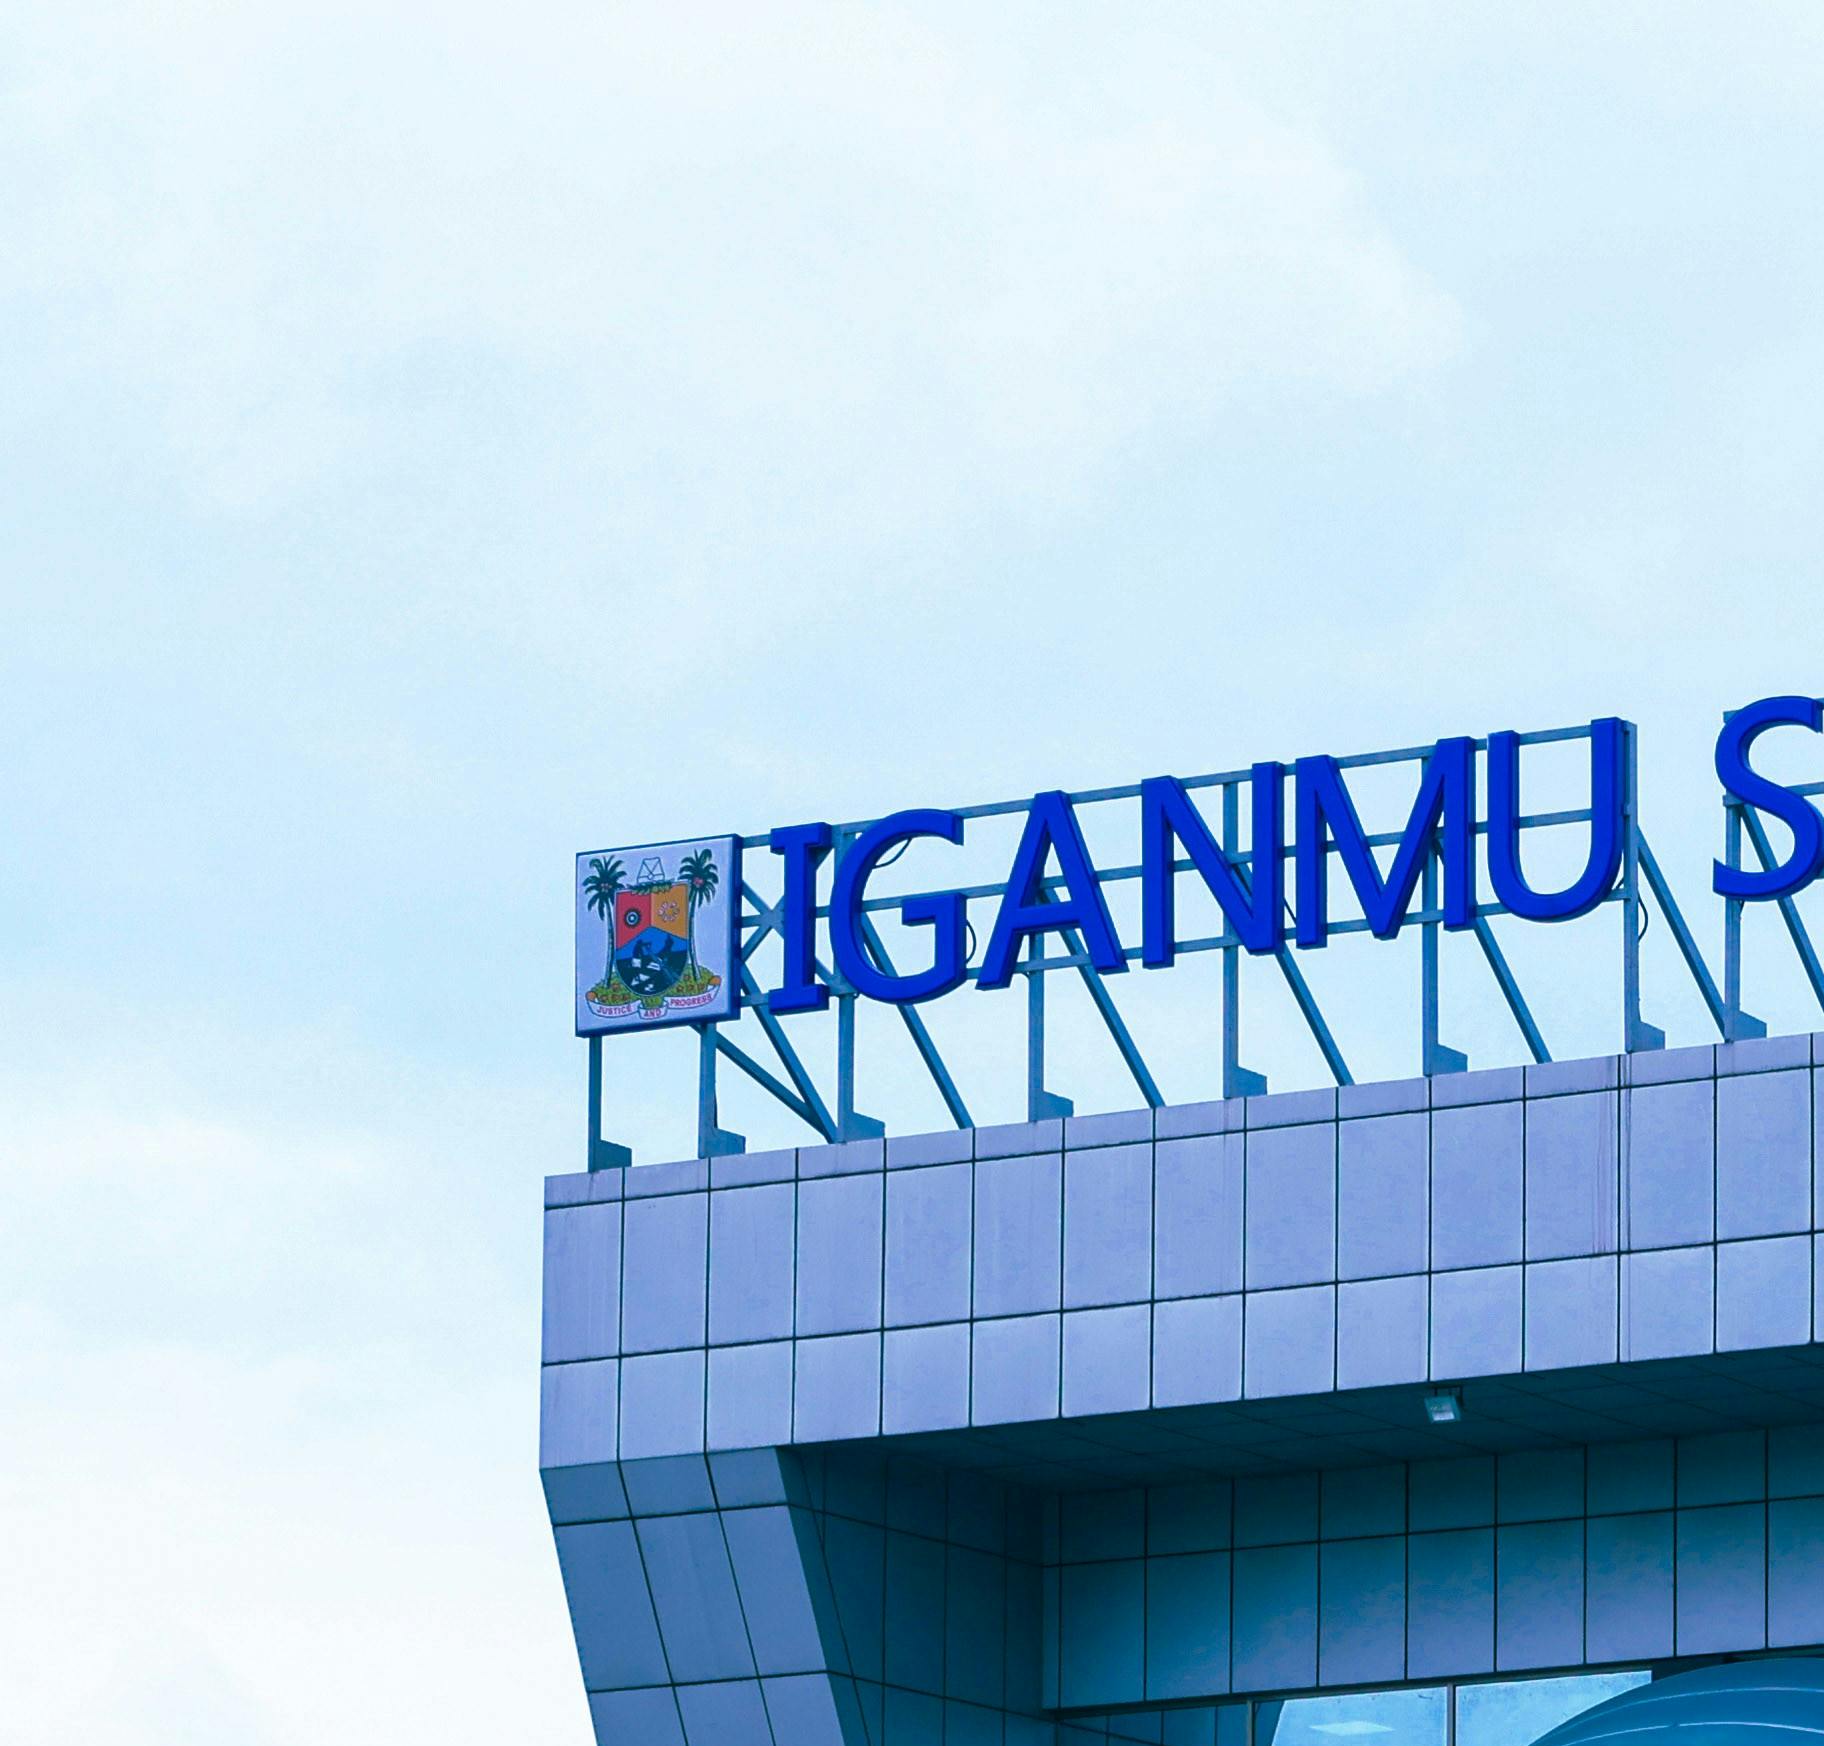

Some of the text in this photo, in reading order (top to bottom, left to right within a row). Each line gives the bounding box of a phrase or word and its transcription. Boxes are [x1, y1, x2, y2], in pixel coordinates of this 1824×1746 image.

[767, 716, 1626, 1016] IGANMU
[596, 994, 712, 1018] JUSTICE AND PROGRESS
